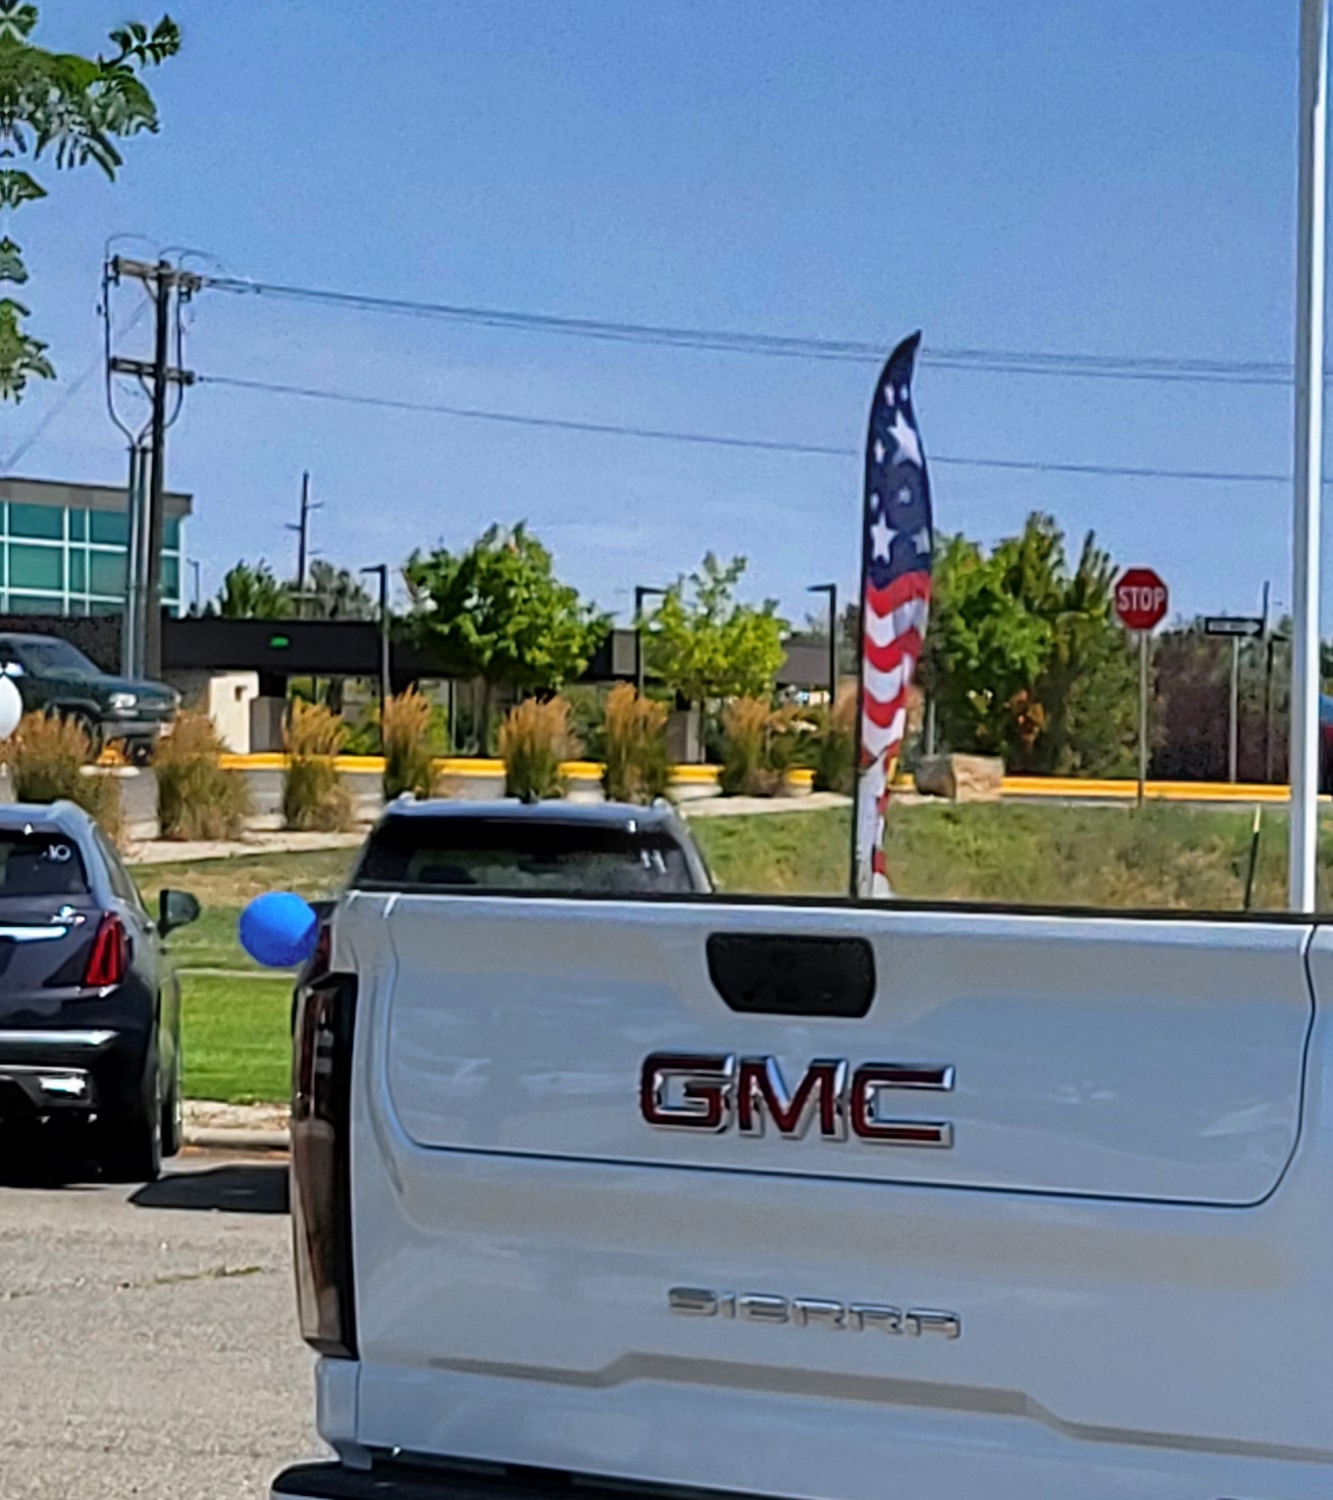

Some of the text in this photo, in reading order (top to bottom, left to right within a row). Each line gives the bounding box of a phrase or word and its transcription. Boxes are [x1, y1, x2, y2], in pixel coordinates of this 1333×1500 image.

[1118, 586, 1165, 611] STOP
[640, 1052, 955, 1149] GMC
[668, 1286, 961, 1340] SIERRA
